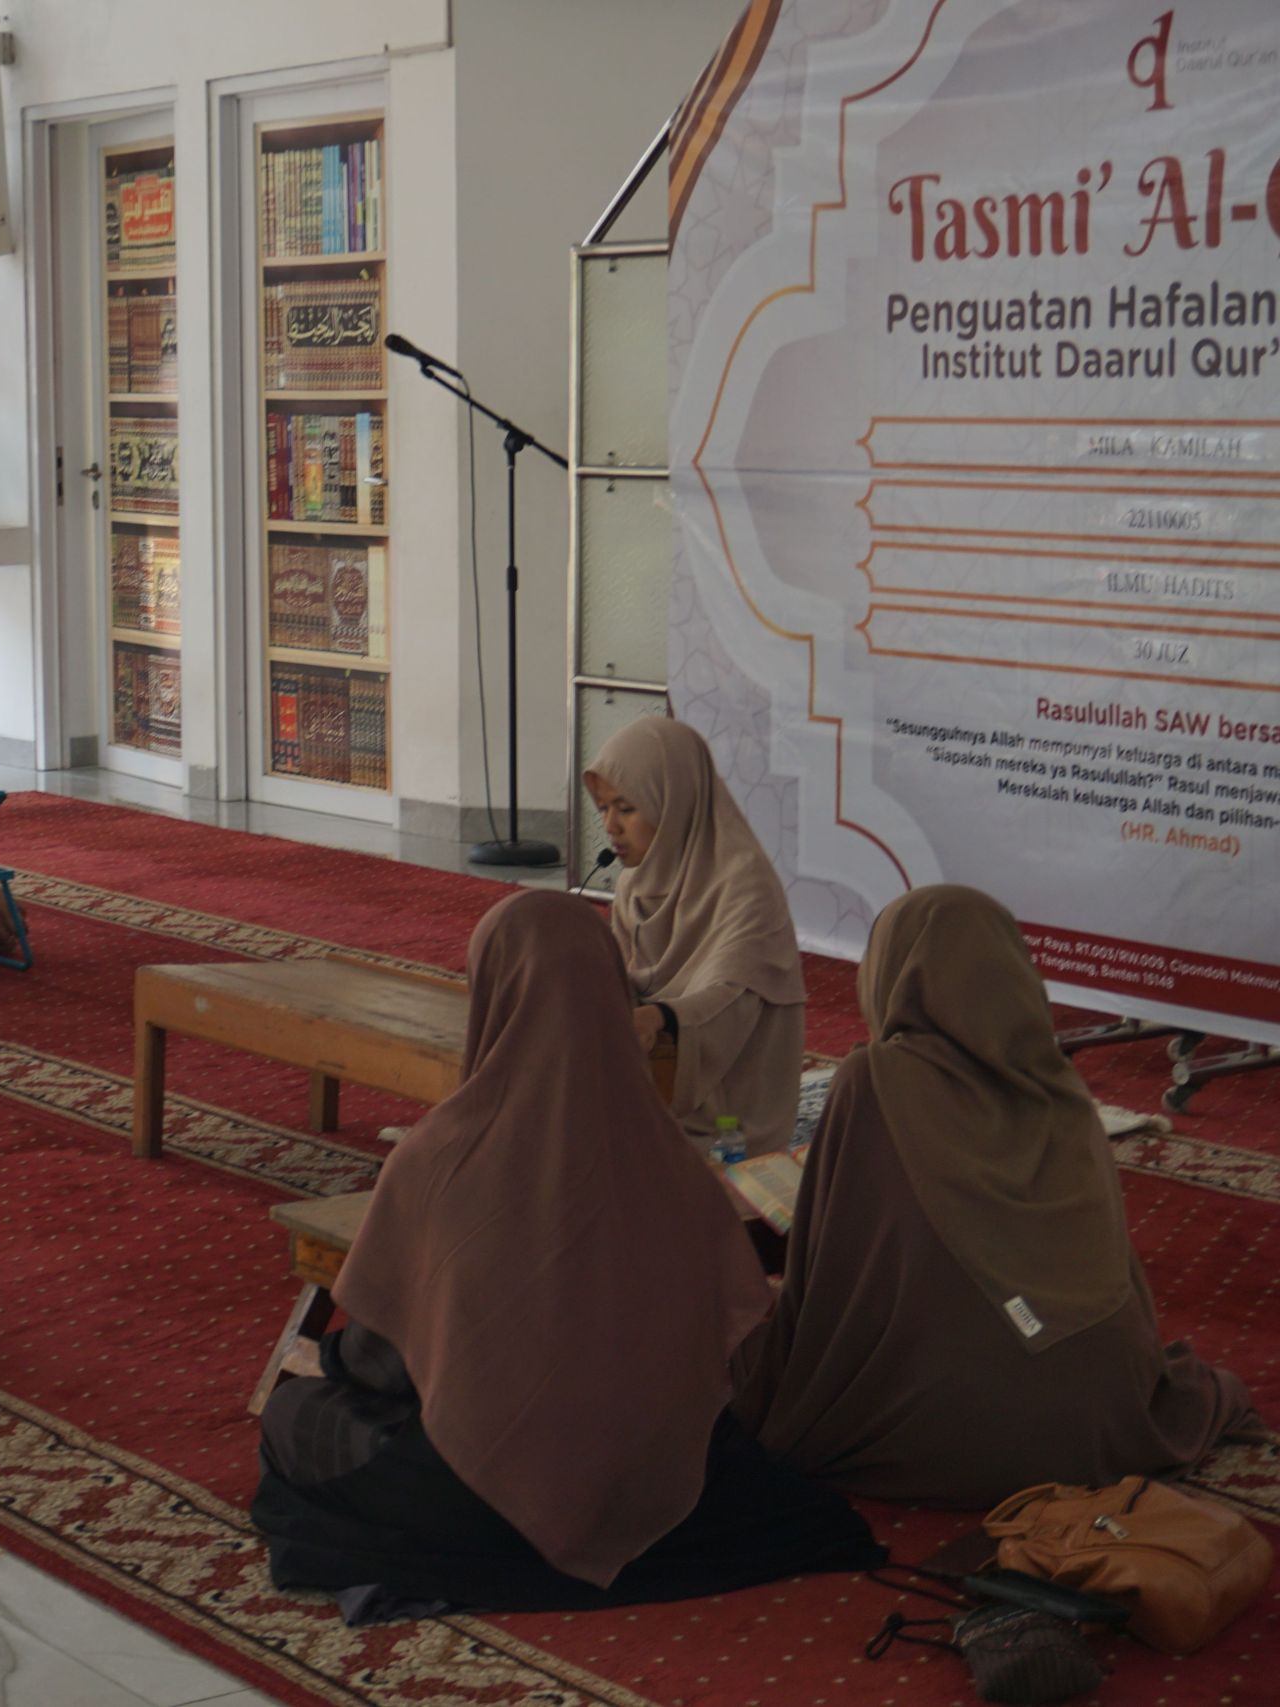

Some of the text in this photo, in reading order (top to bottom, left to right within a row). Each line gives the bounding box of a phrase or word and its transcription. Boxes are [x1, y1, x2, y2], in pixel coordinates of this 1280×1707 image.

[1123, 146, 1280, 260] Al-
[886, 280, 1277, 342] Penguatan Hafalan
[921, 340, 1043, 380] Institut
[1055, 337, 1176, 379] Daarul
[1088, 435, 1243, 459] MILA KAMILAH
[1106, 571, 1236, 601] ILMU HADITS
[1133, 639, 1191, 665] 30 JUZ
[1036, 697, 1147, 731] Rasulullah
[1154, 708, 1212, 737] SAW
[989, 730, 1025, 749] Allah
[1028, 737, 1113, 761] mempunyai
[1116, 746, 1183, 770] keluarga
[1186, 752, 1203, 772] di
[1206, 756, 1259, 778] antara
[994, 755, 1048, 776] mereka
[1050, 763, 1068, 781] ya
[1167, 775, 1211, 797] Rasul
[997, 776, 1070, 802] Merekalah
[1072, 787, 1138, 814] keluarga
[1141, 797, 1182, 818] Allah
[1185, 802, 1216, 823] dan
[1164, 826, 1242, 857] Ahmad)
